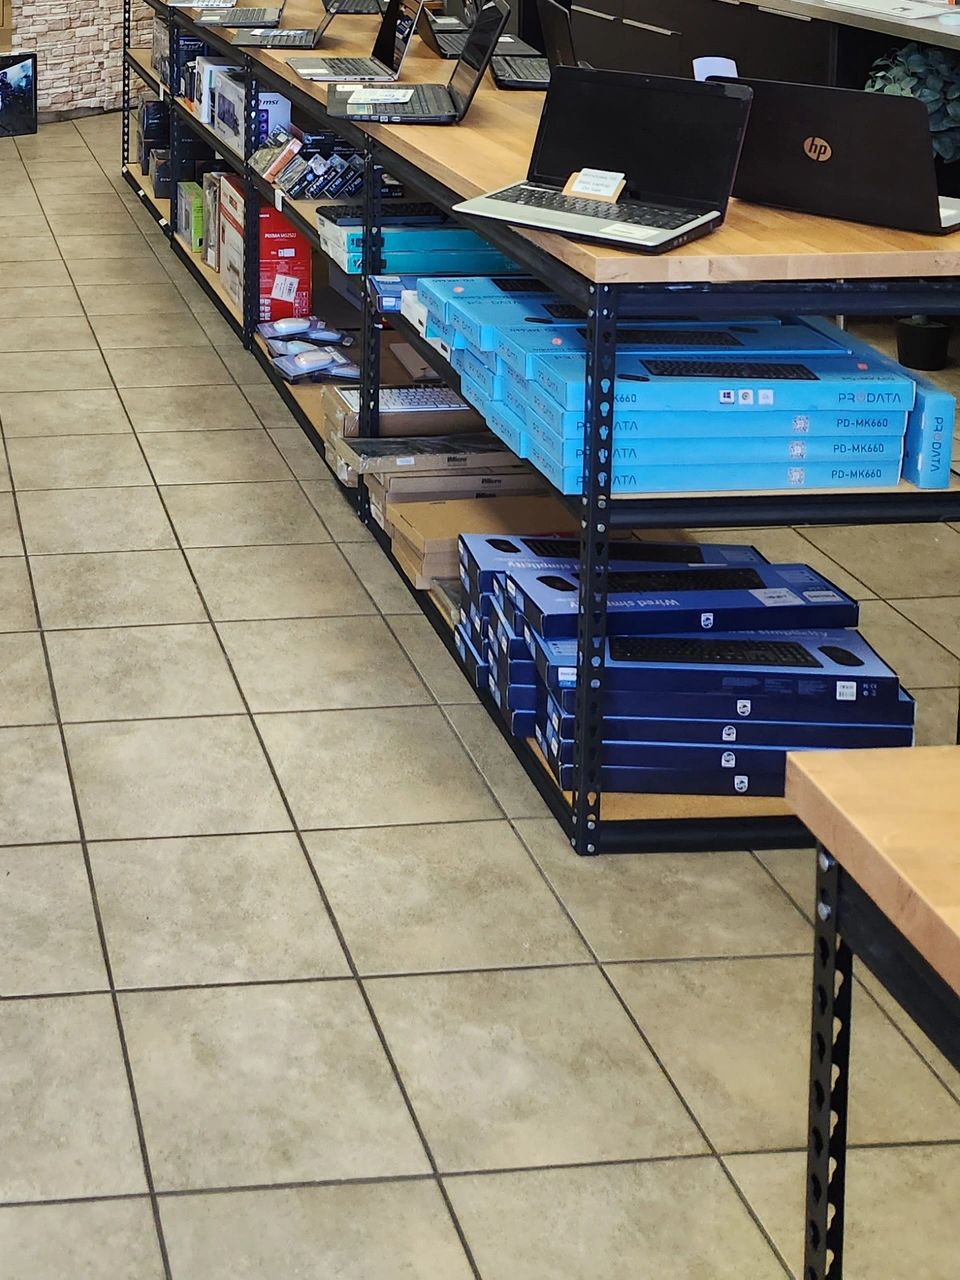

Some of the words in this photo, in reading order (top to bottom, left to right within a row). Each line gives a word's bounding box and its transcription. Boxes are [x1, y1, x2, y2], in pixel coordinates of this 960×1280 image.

[838, 392, 902, 404] PRODATA
[836, 418, 888, 428] PD-MK660
[833, 443, 884, 454] PD-MK660
[930, 416, 944, 473] PRODATA
[831, 469, 882, 480] PD-MK660
[639, 599, 680, 607] Wired
